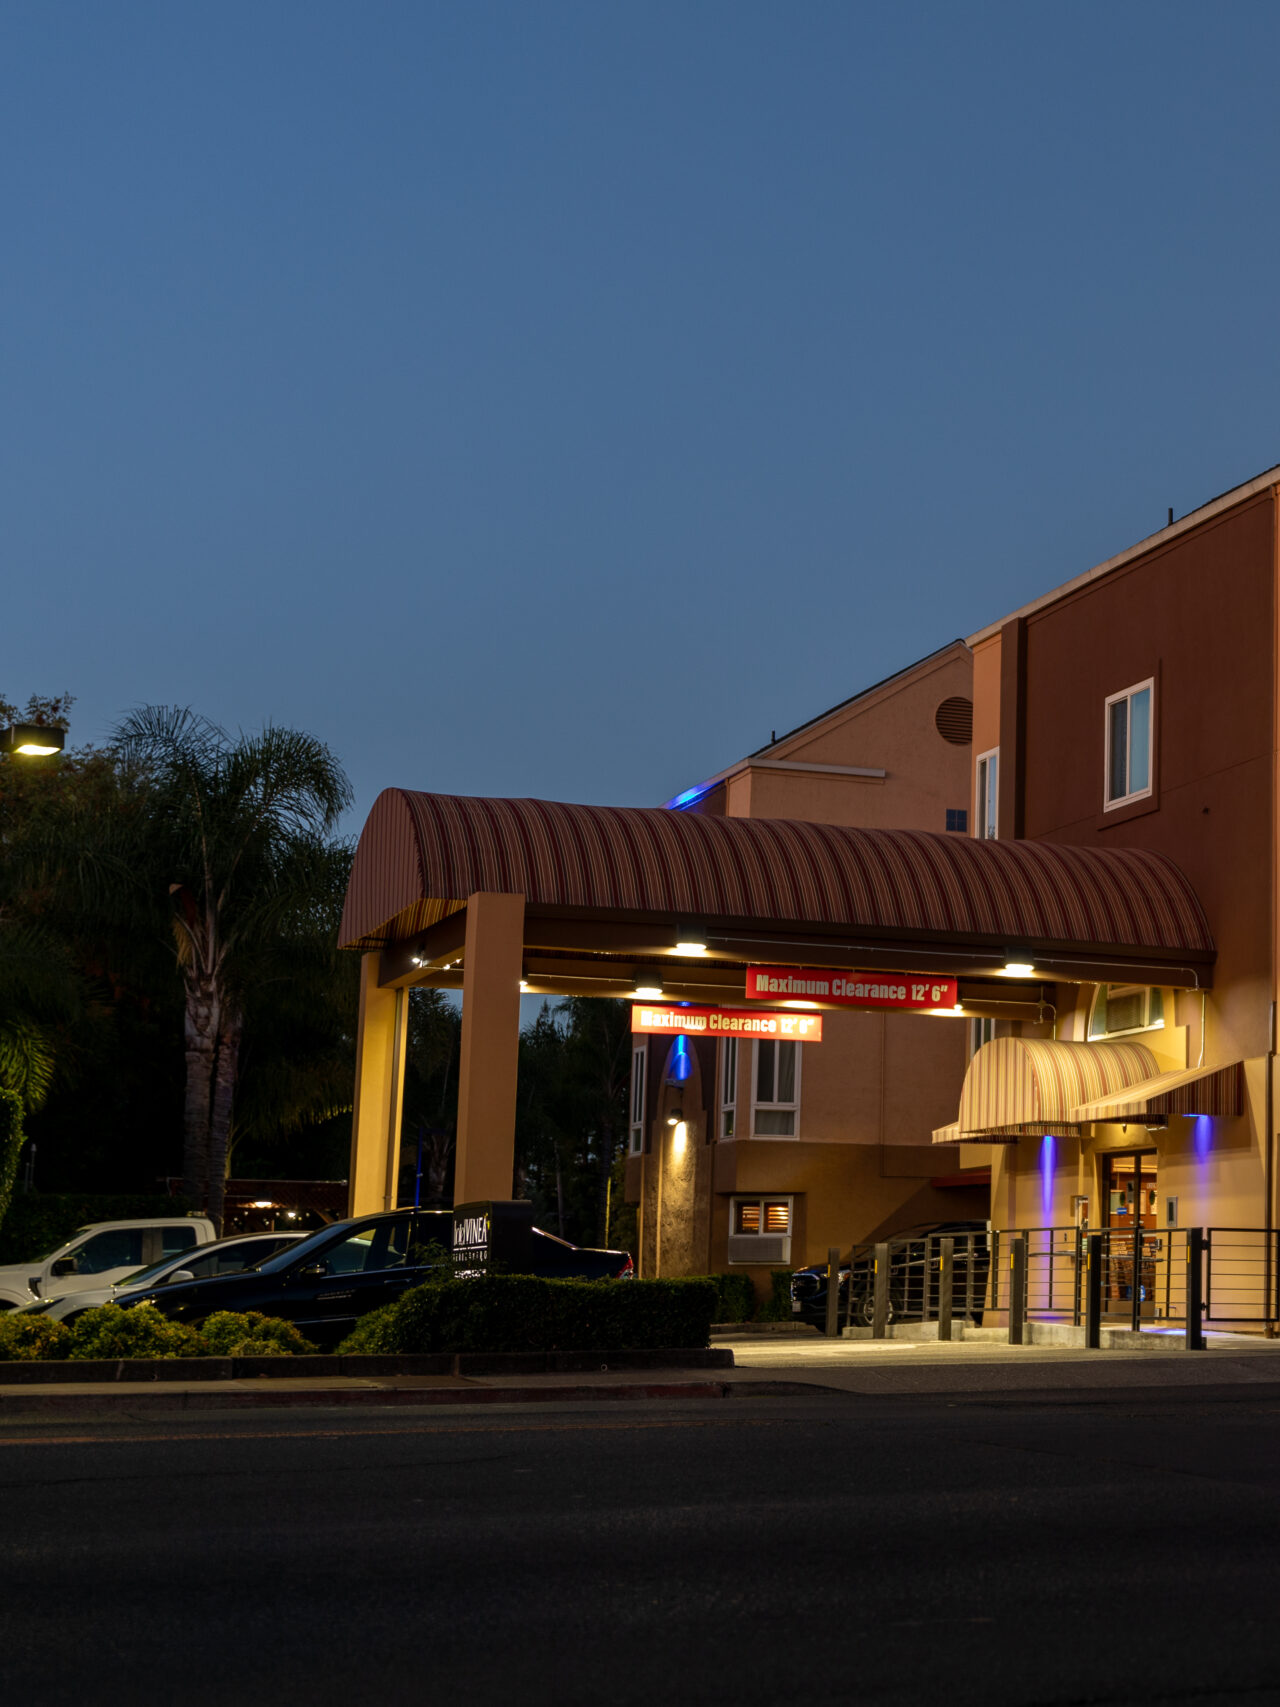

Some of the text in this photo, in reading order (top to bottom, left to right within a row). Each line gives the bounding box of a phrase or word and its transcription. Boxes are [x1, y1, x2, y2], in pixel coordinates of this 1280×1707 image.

[756, 974, 829, 996] Maximum
[832, 978, 906, 1000] Clearance
[911, 984, 929, 1001] 12'
[640, 1010, 707, 1031] Maximum
[709, 1014, 777, 1033] Clearance
